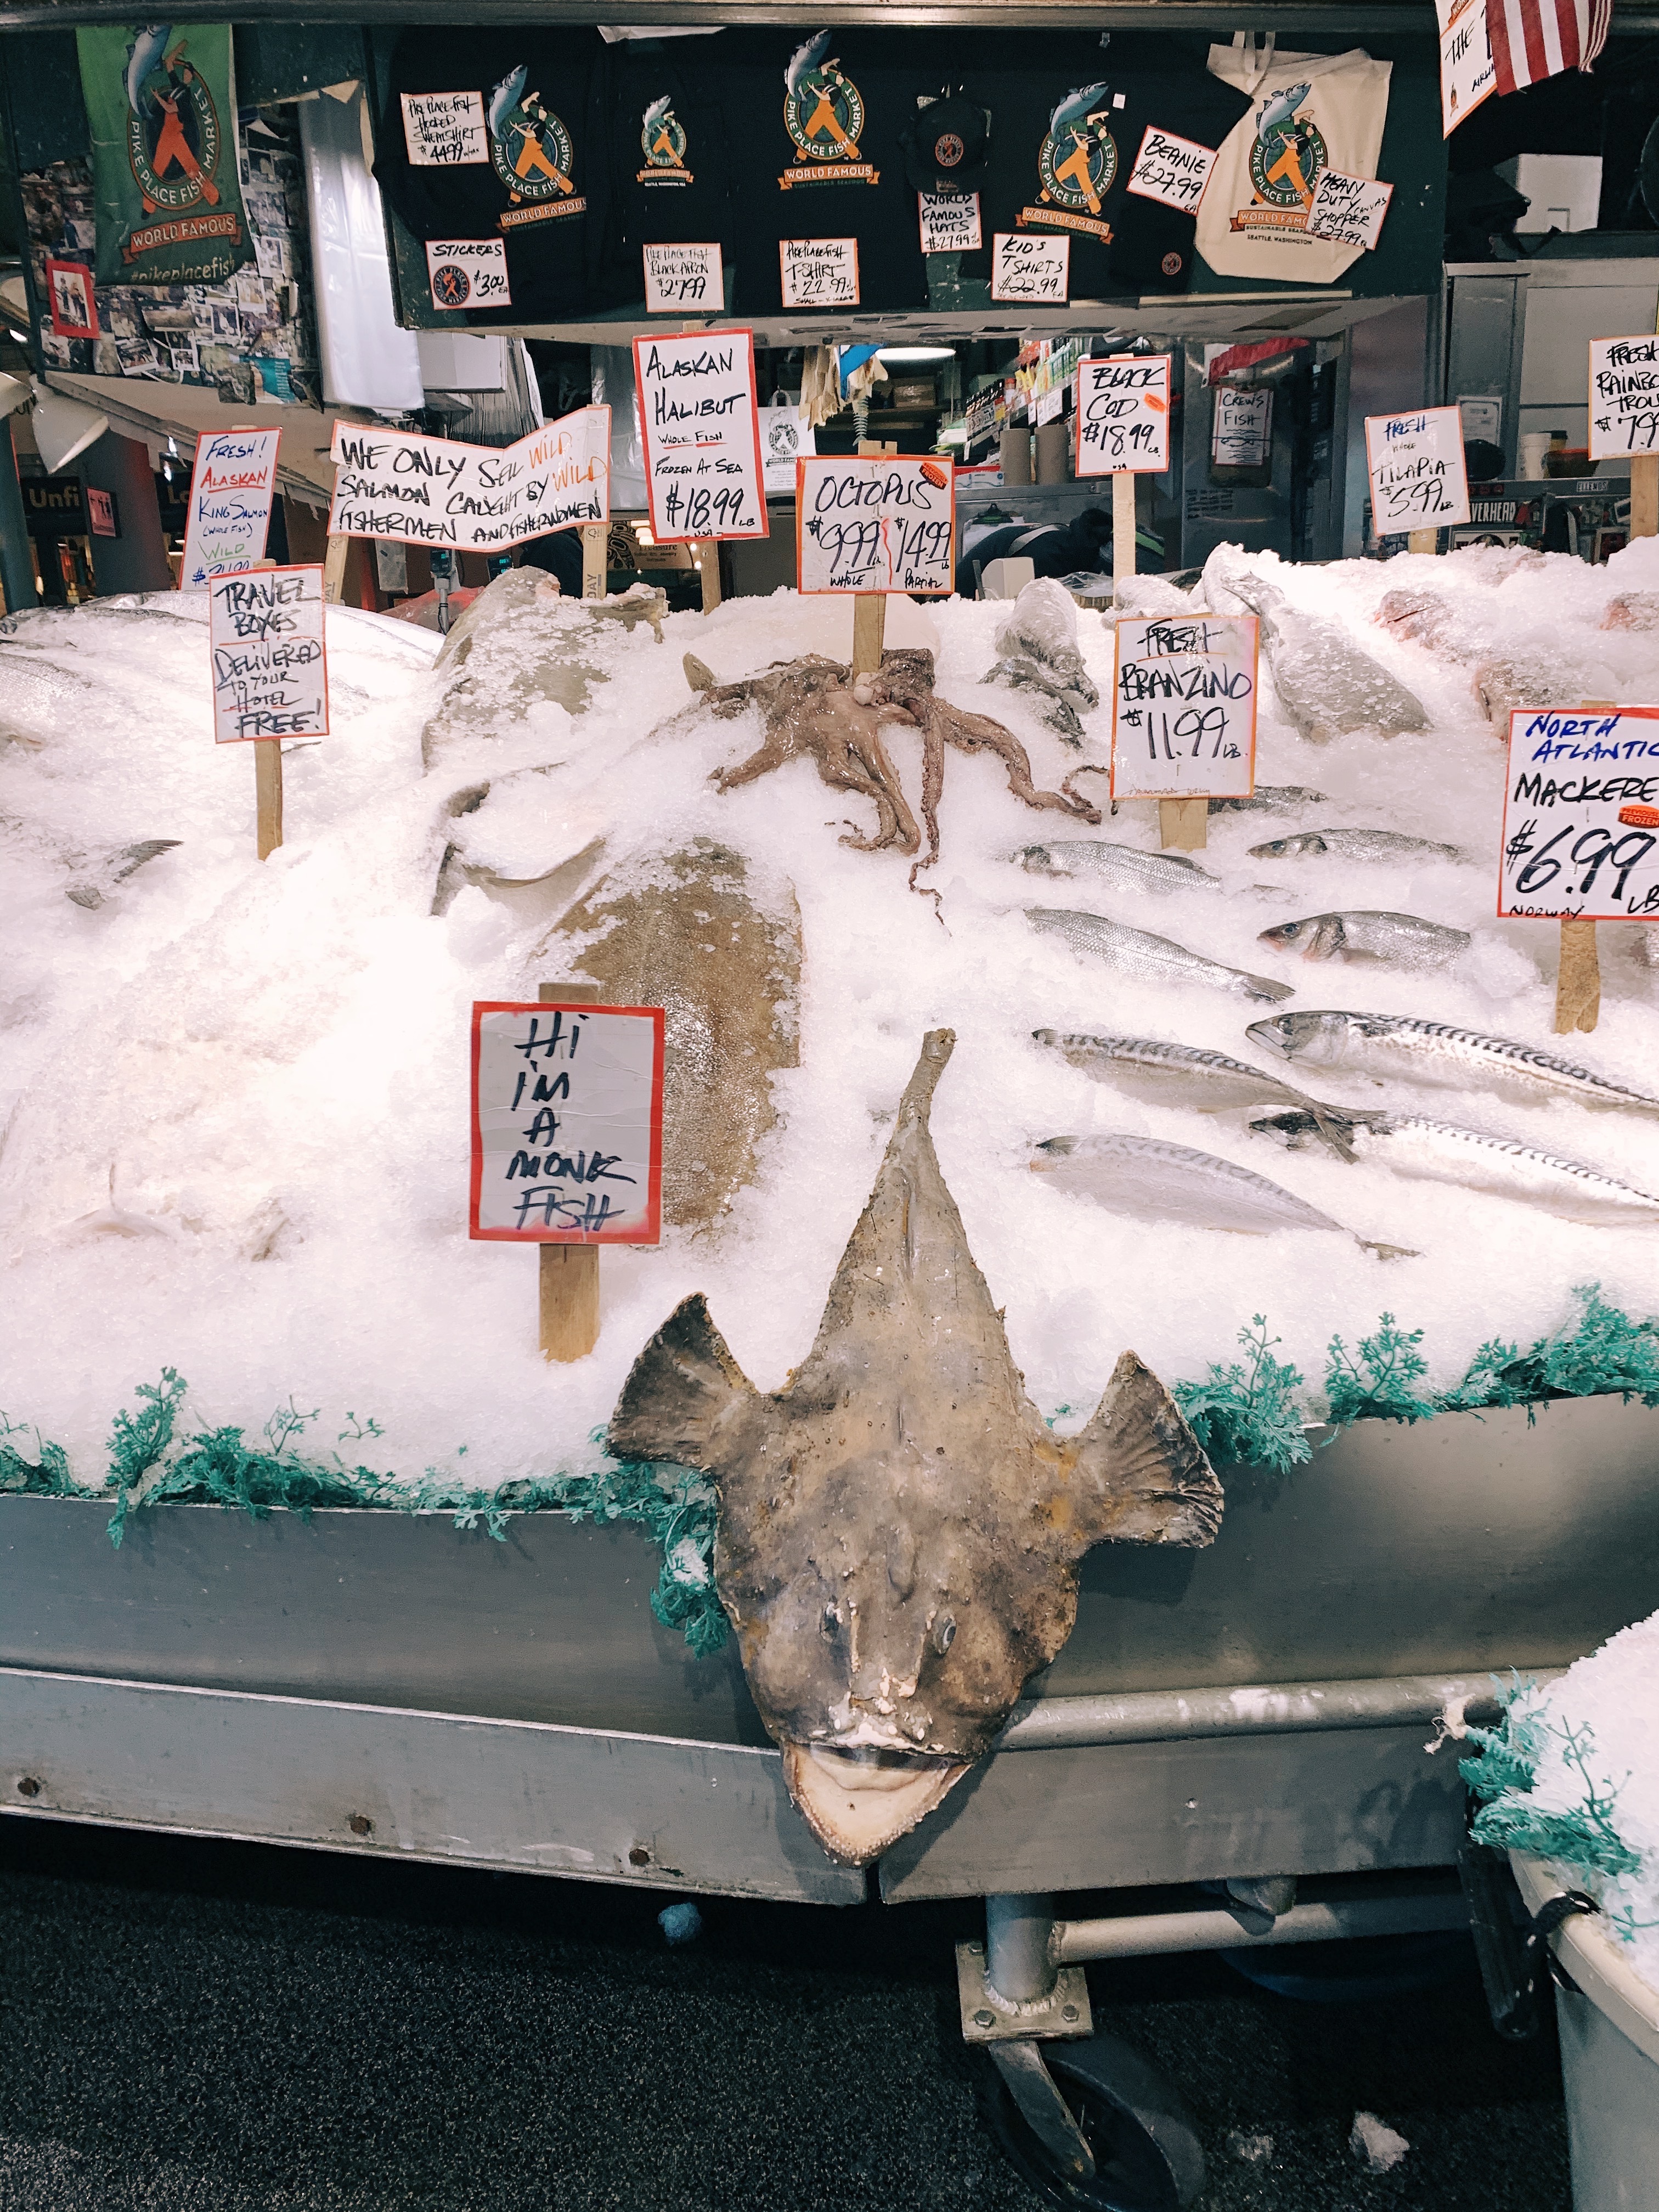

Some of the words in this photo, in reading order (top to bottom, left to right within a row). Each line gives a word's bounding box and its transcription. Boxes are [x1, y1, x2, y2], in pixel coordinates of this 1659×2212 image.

[1445, 18, 1476, 66] THE
[427, 95, 453, 114] PLACE
[451, 95, 479, 114] FISH
[410, 125, 486, 143] SWEATSHIRT
[413, 115, 456, 131] HOODED
[787, 101, 798, 130] PIKE
[794, 132, 825, 156] PLACE
[828, 138, 850, 156] FISH
[844, 88, 861, 138] MARKET
[131, 121, 144, 167] PIKE
[140, 169, 177, 204] PLACE
[179, 171, 206, 202] FISH
[194, 87, 216, 169] MARKET
[549, 120, 570, 172] MARKET
[1042, 140, 1054, 169] PIKE
[1144, 134, 1206, 174] BEANIE
[1252, 144, 1263, 173] PIKE
[494, 144, 507, 174] PIKE
[1096, 144, 1115, 193] MARKET
[505, 173, 539, 196] PLACE
[541, 173, 563, 194] FISH
[786, 168, 824, 179] WORLD
[827, 166, 872, 177] FAMOUS
[1132, 160, 1203, 200] $27.99
[1320, 172, 1365, 199] HEAVY
[922, 194, 972, 205] WORLD
[1043, 173, 1069, 203] PLACE
[1071, 190, 1095, 205] FISH
[1256, 176, 1282, 203] PLACE
[1285, 189, 1310, 203] FISH
[922, 206, 975, 222] FAMOUS
[1317, 189, 1361, 215] DUTY
[1354, 197, 1387, 214] CANVAS
[502, 208, 541, 224] WORLD
[929, 220, 970, 234] HATS
[1025, 209, 1062, 223] WORLD
[1064, 216, 1107, 234] FAMOUS
[1240, 212, 1278, 222] WORLD
[1313, 209, 1370, 228] SHOPPER
[133, 224, 178, 247] WORLD
[180, 217, 234, 237] FAMOUS
[925, 234, 969, 250] $27.99
[1002, 235, 1046, 254] KID'S
[1311, 222, 1362, 246] $27.99
[432, 244, 502, 256] STICKERS
[650, 260, 680, 276] BLACK
[680, 261, 709, 275] APRON
[785, 262, 845, 280] T-SHIRT
[1002, 255, 1017, 269] T
[1012, 259, 1063, 275] SHIRTS
[473, 269, 504, 297] $3.00
[656, 276, 706, 301] $27.99
[789, 277, 847, 296] $22.99
[997, 275, 1058, 295] $22.99
[646, 345, 732, 381] ALASKAN
[1606, 341, 1659, 367] FRESH
[1092, 367, 1165, 390] BLACK
[655, 386, 746, 426] HALIBUT
[1086, 393, 1138, 421] COD
[1224, 410, 1261, 426] FISH
[658, 433, 692, 445] WHOLE
[695, 431, 722, 442] FISH
[1082, 422, 1155, 456] $18.99
[1383, 415, 1438, 441] FRESH
[341, 438, 393, 470] WE
[393, 446, 466, 490] ONLY
[478, 458, 524, 488] SELL
[528, 431, 573, 469] WILD
[1392, 442, 1416, 453] WHOLE
[200, 466, 268, 489] ALASKAN
[656, 456, 692, 477] FROZEN
[696, 458, 712, 475] AT
[715, 458, 743, 473] SEA
[922, 468, 943, 488] FROZEN
[1372, 457, 1455, 484] TILAPIA
[337, 474, 430, 506] SALMON
[445, 487, 524, 516] CAUGHT
[526, 472, 549, 507] BY
[551, 456, 608, 492] WILD
[815, 473, 932, 512] OCTOPUS
[1379, 478, 1443, 517] $5.99
[199, 495, 230, 522] KING
[229, 494, 268, 521] SALMON
[339, 500, 457, 541] FISHERMEN
[471, 523, 510, 543] AND
[509, 488, 602, 540] FISHERWOMEN
[665, 481, 744, 531] $18.99
[739, 518, 755, 527] LB
[1470, 501, 1516, 522] VERHEAD
[198, 541, 245, 561] WILD
[805, 515, 880, 573] $9.99
[894, 517, 952, 573] $14.99
[830, 573, 865, 588] WHOLE
[905, 568, 943, 589] PARTIAL
[213, 574, 321, 613] TRAVEL
[229, 609, 301, 641] BOXES
[1137, 618, 1223, 657] FRESH
[215, 640, 321, 685] DELIVERED
[215, 680, 247, 697] TO
[250, 671, 299, 690] YOUR
[1118, 659, 1252, 701] BRANZINO
[229, 687, 304, 713] HOTEL
[234, 698, 321, 738] FREE!
[1525, 710, 1622, 738] NORTH
[1120, 707, 1230, 760] $11.99
[1622, 814, 1659, 826] FROZEN
[1506, 819, 1657, 900] $6.99
[1509, 905, 1585, 919] NORWAY
[522, 1107, 561, 1147] A
[505, 1150, 637, 1184] MONK
[512, 1186, 629, 1232] FISH
